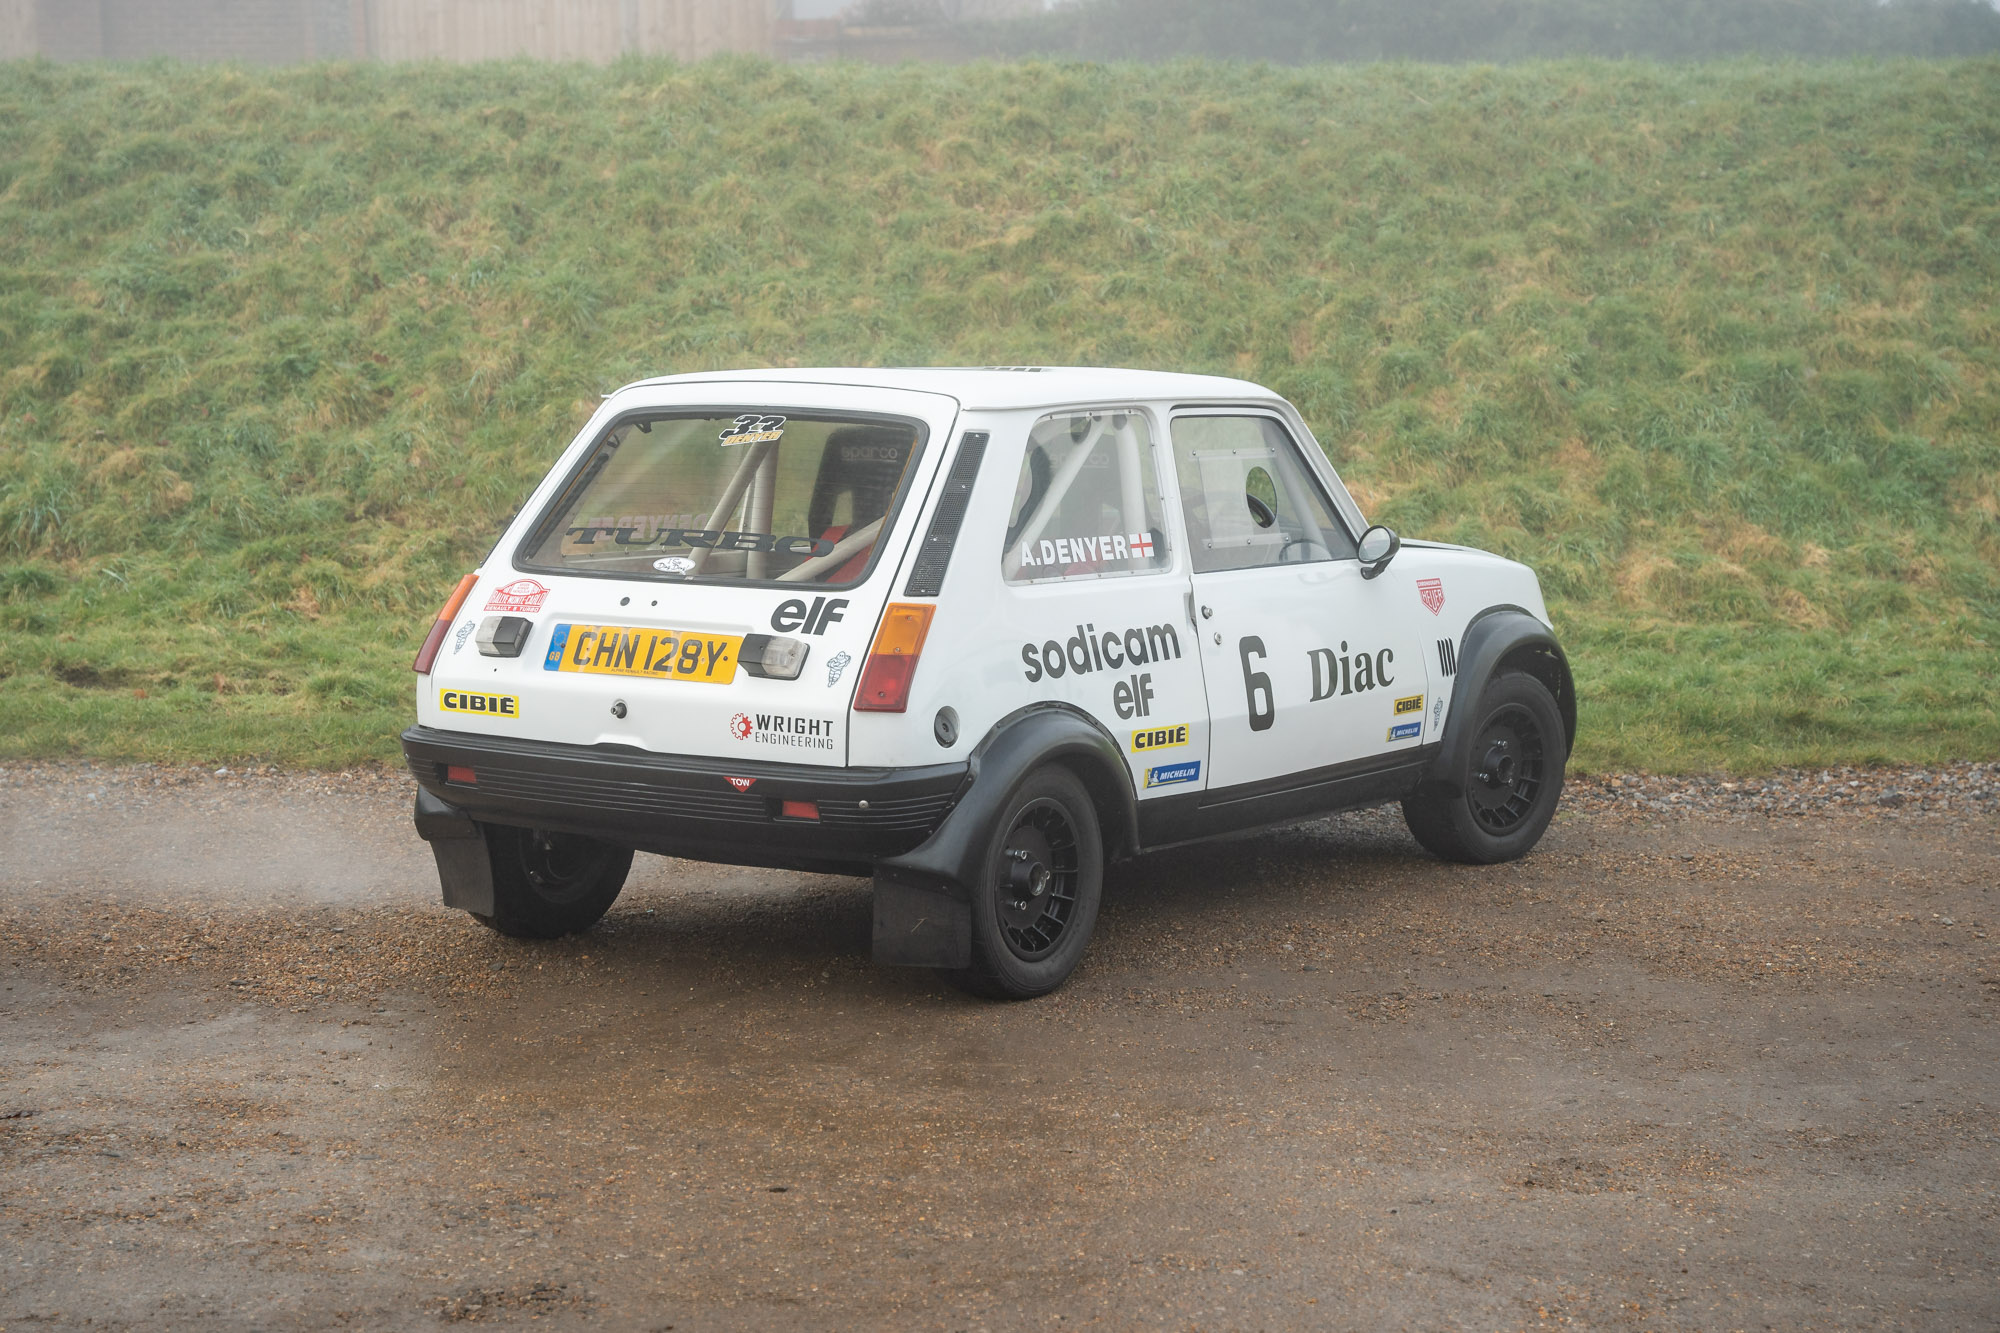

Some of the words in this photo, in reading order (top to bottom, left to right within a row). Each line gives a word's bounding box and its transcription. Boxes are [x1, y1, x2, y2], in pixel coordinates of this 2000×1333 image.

[724, 430, 782, 445] DENYER
[841, 446, 898, 462] sparco
[566, 527, 835, 558] TURBO
[1021, 534, 1129, 567] A.DENYER
[1422, 590, 1442, 609] HEUER
[771, 596, 849, 635] elf
[549, 651, 560, 661] GB
[573, 631, 640, 668] CHN
[643, 636, 727, 676] 128Y
[1022, 623, 1181, 682] sodicam
[1307, 640, 1395, 702] Diac
[1239, 635, 1275, 732] 6
[1113, 673, 1154, 720] elf
[755, 714, 833, 737] WRIGHT
[1396, 727, 1418, 736] MICHELIN
[755, 731, 833, 750] ENGINEERING
[730, 778, 750, 787] TOW
[1160, 768, 1197, 780] MICHELIN
